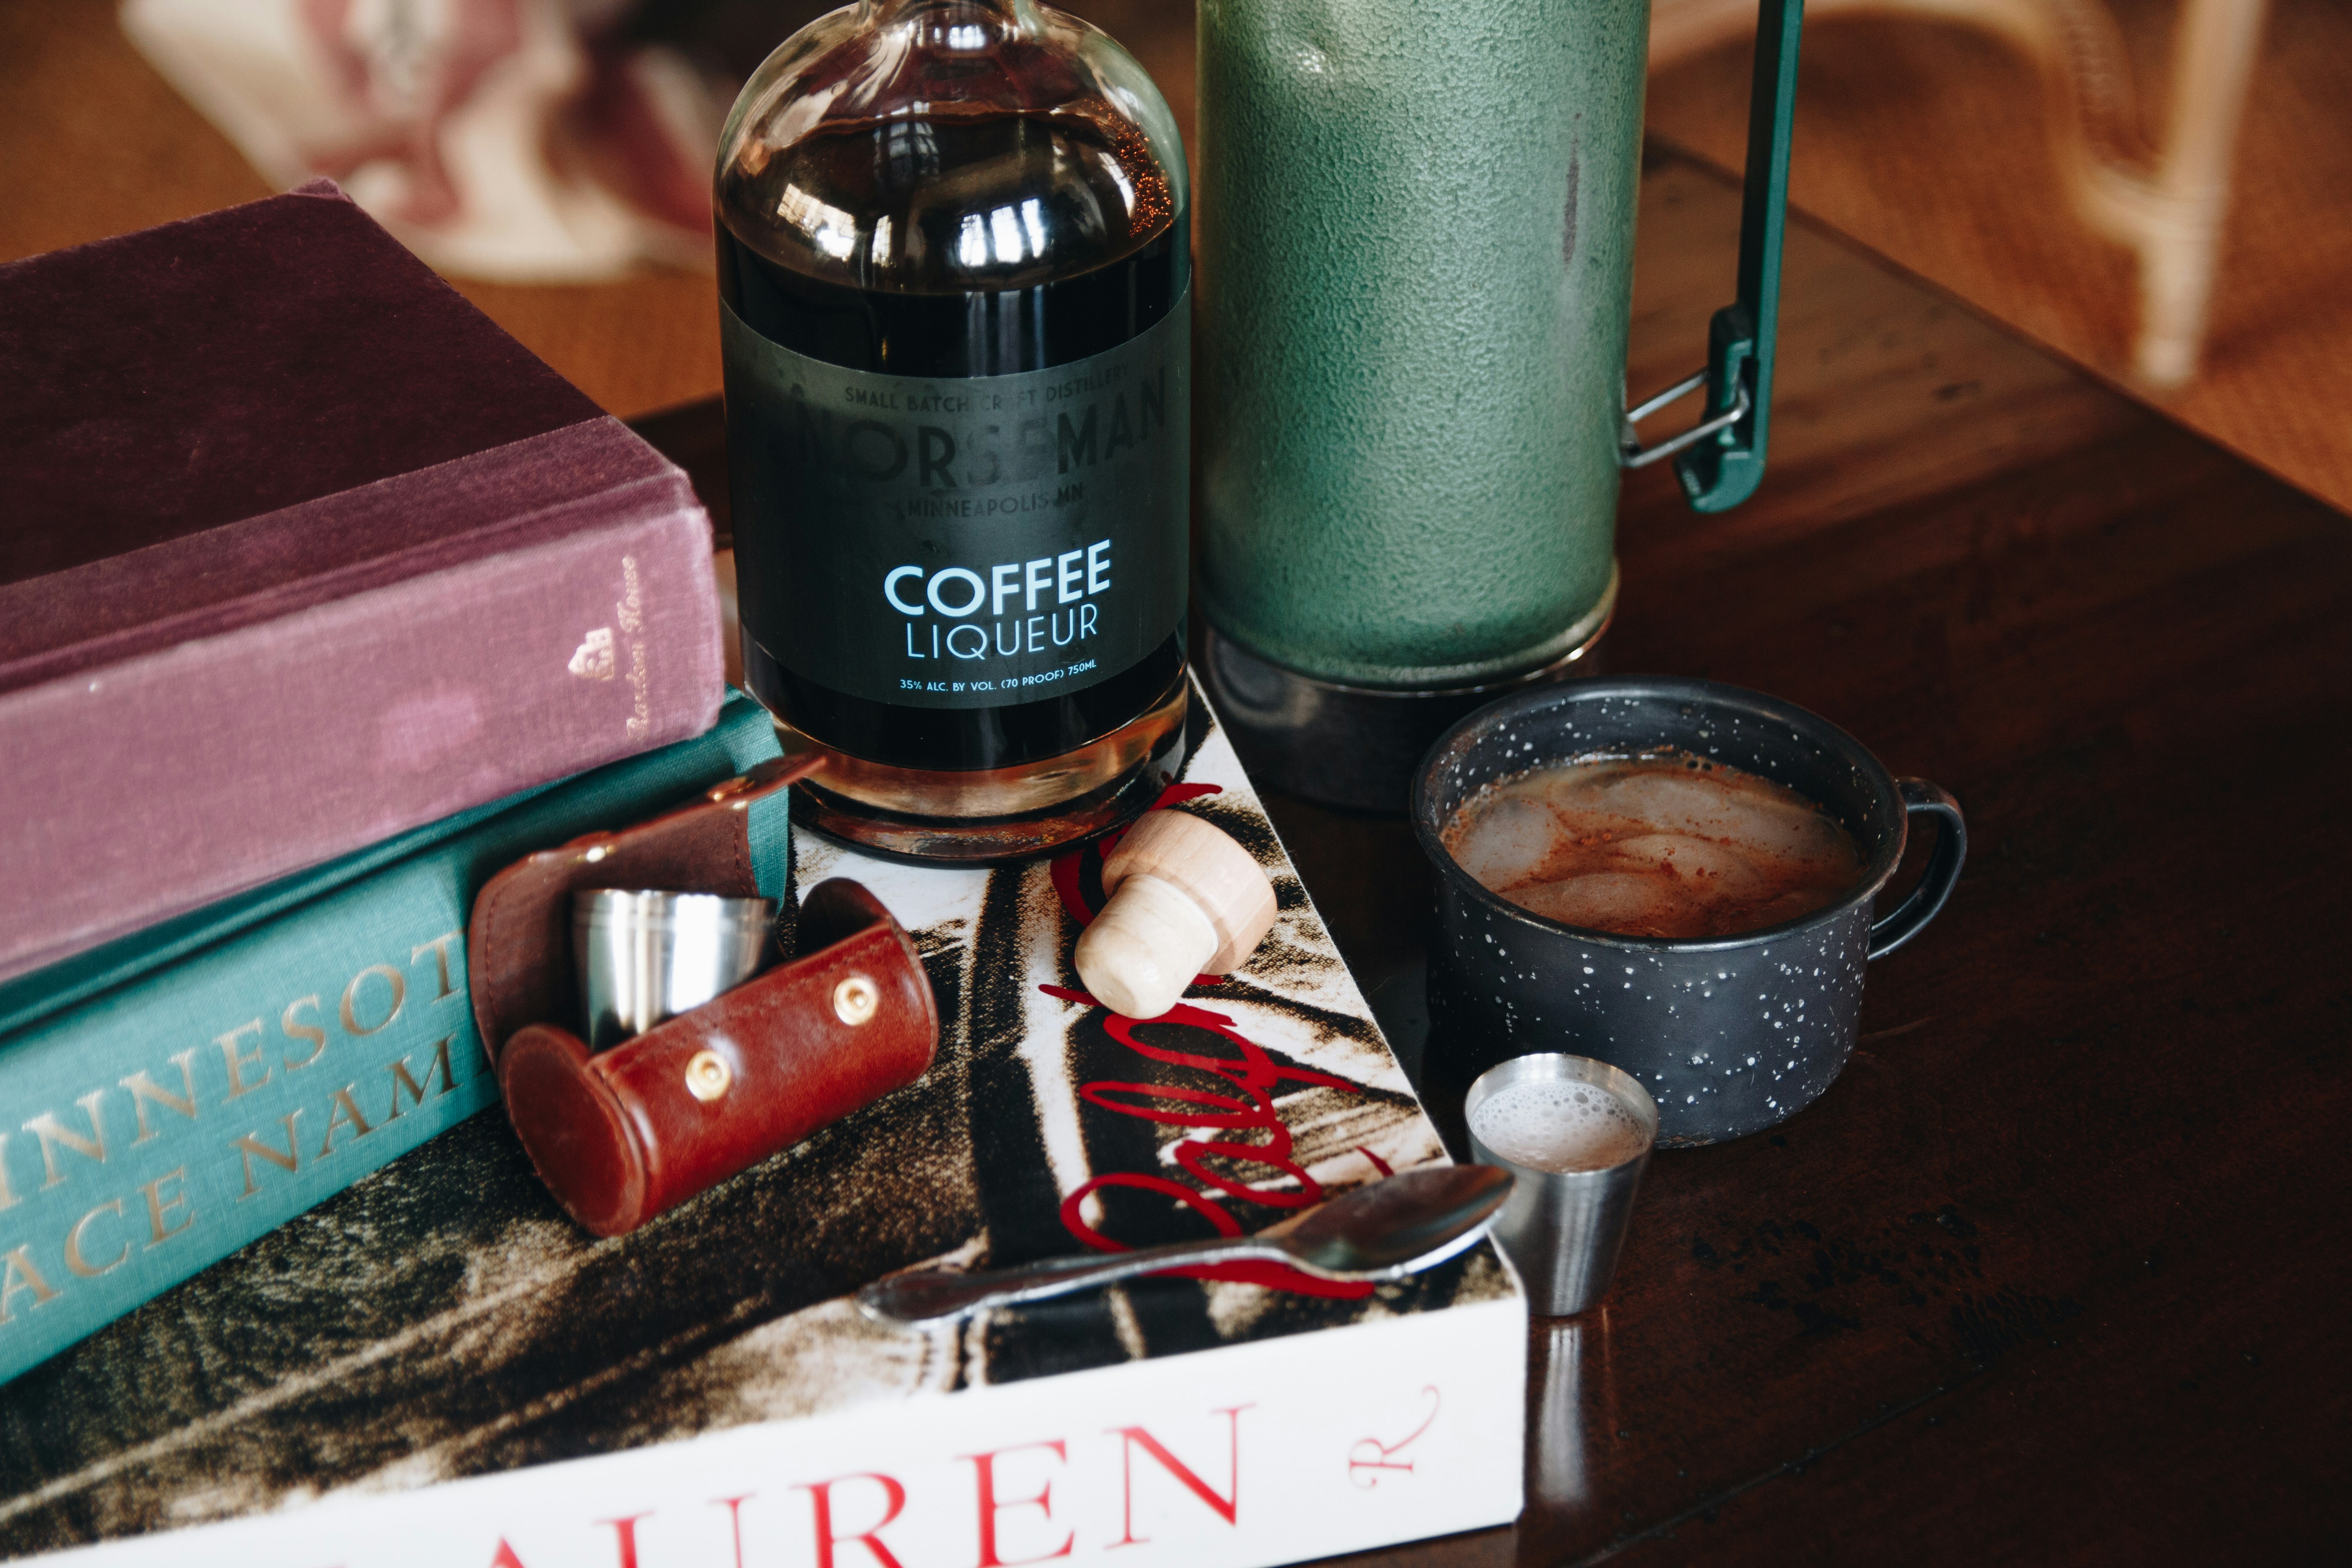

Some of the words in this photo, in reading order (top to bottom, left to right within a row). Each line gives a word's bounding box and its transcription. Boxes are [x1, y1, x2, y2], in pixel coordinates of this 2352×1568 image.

[845, 386, 898, 410] SMALL
[907, 395, 968, 412] BATCH
[980, 388, 1037, 410] CRFT
[1046, 362, 1129, 403] DISTILLERY
[909, 493, 1049, 518] MINNEAPOLIS
[1057, 481, 1083, 502] MN
[884, 539, 1111, 617] COFFEE
[906, 603, 1097, 660] LIQUEUR
[900, 679, 922, 689] 35%
[927, 682, 948, 692] ALC.
[952, 682, 965, 692] BY
[970, 681, 996, 690] VOL.
[1001, 678, 1018, 689] (70
[1022, 669, 1064, 686] PROOF)
[1068, 658, 1096, 676] 750ML
[228, 1032, 490, 1204] NAM
